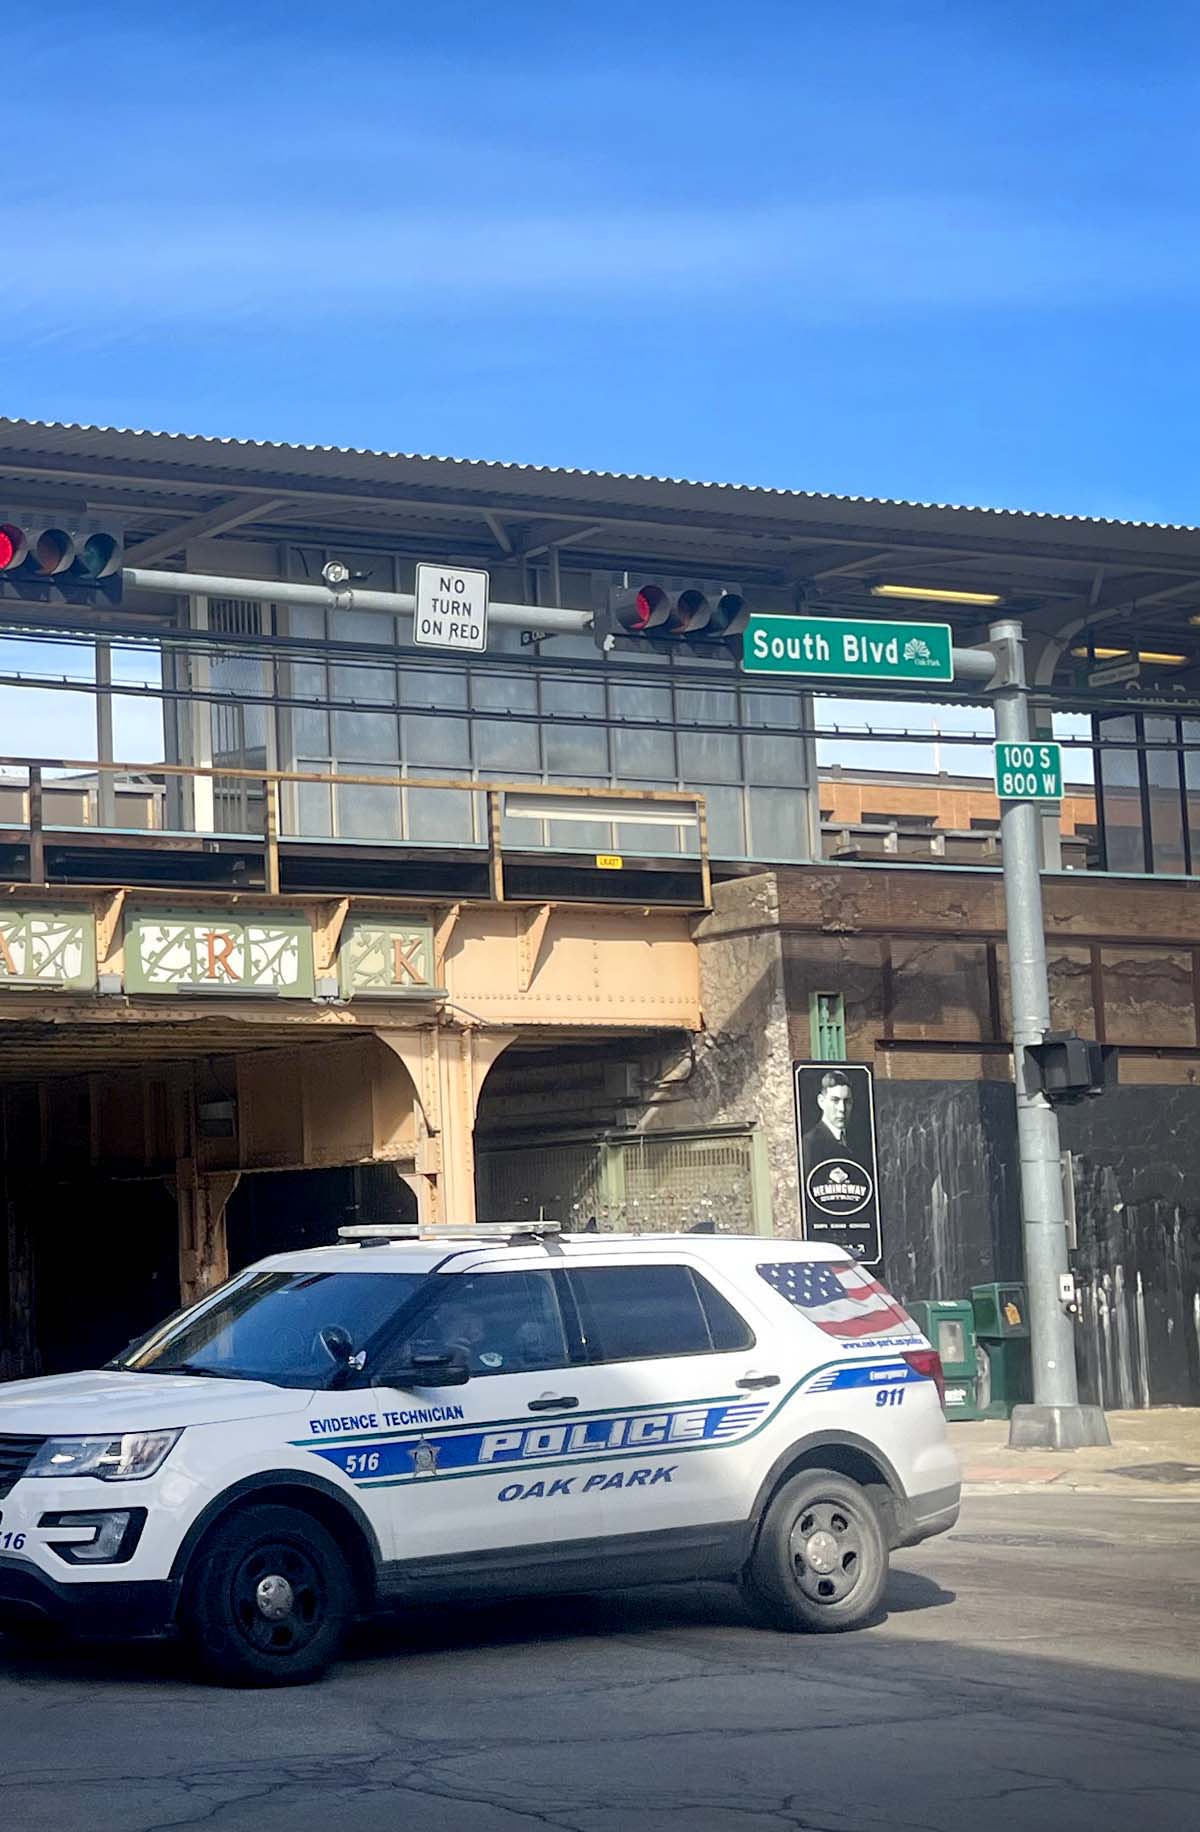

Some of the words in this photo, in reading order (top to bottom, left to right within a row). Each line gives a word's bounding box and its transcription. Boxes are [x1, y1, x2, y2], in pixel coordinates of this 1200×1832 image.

[440, 577, 465, 594] NO
[431, 598, 472, 617] TURN
[421, 619, 443, 636] ON
[450, 622, 480, 640] RED
[753, 629, 830, 661] South
[842, 634, 898, 665] Blvd
[1004, 747, 1034, 768] 100
[1040, 748, 1051, 769] S
[1002, 773, 1037, 794] 800
[1042, 774, 1056, 795] W
[812, 1184, 867, 1197] HEMINGWAY
[875, 1387, 905, 1407] 911
[309, 1413, 379, 1434] EVIDENCE
[383, 1405, 465, 1427] TECHNICIAN
[478, 1410, 709, 1462] POLICE
[345, 1452, 380, 1473] 516
[497, 1477, 578, 1502] OAK
[582, 1465, 680, 1493] PARK
